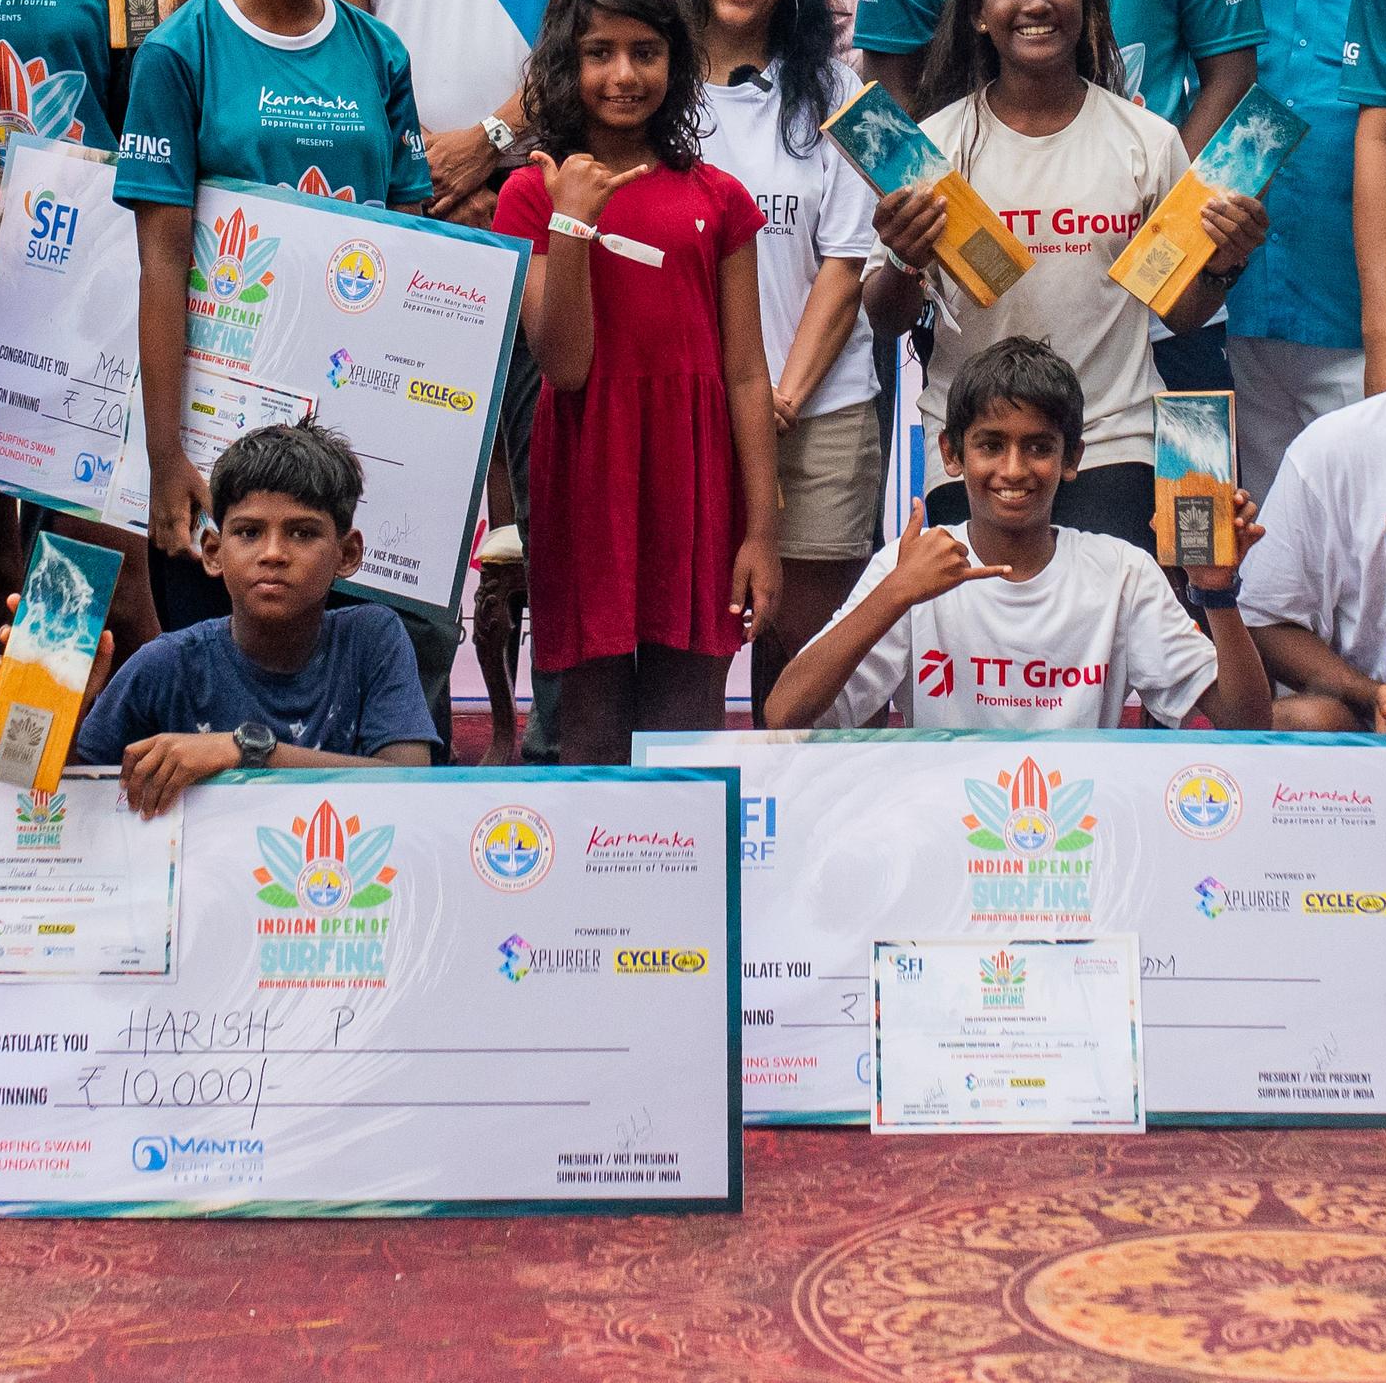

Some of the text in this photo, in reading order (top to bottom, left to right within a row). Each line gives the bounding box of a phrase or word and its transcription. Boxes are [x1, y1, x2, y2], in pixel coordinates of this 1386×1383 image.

[259, 86, 360, 112] Karnataka
[296, 137, 335, 148] PRESENTS
[31, 199, 79, 246] SFI
[1000, 208, 1141, 239] TT Group
[26, 240, 71, 265] SURF
[970, 657, 1013, 687] TT
[976, 693, 1062, 710] Promises kept
[968, 859, 1093, 874] INDIAN OPEN OF
[257, 918, 390, 935] INDIAN OPEN OF
[118, 1005, 356, 1057] HARISH P
[62, 1034, 89, 1052] YOU
[171, 1135, 264, 1156] MANTRA
